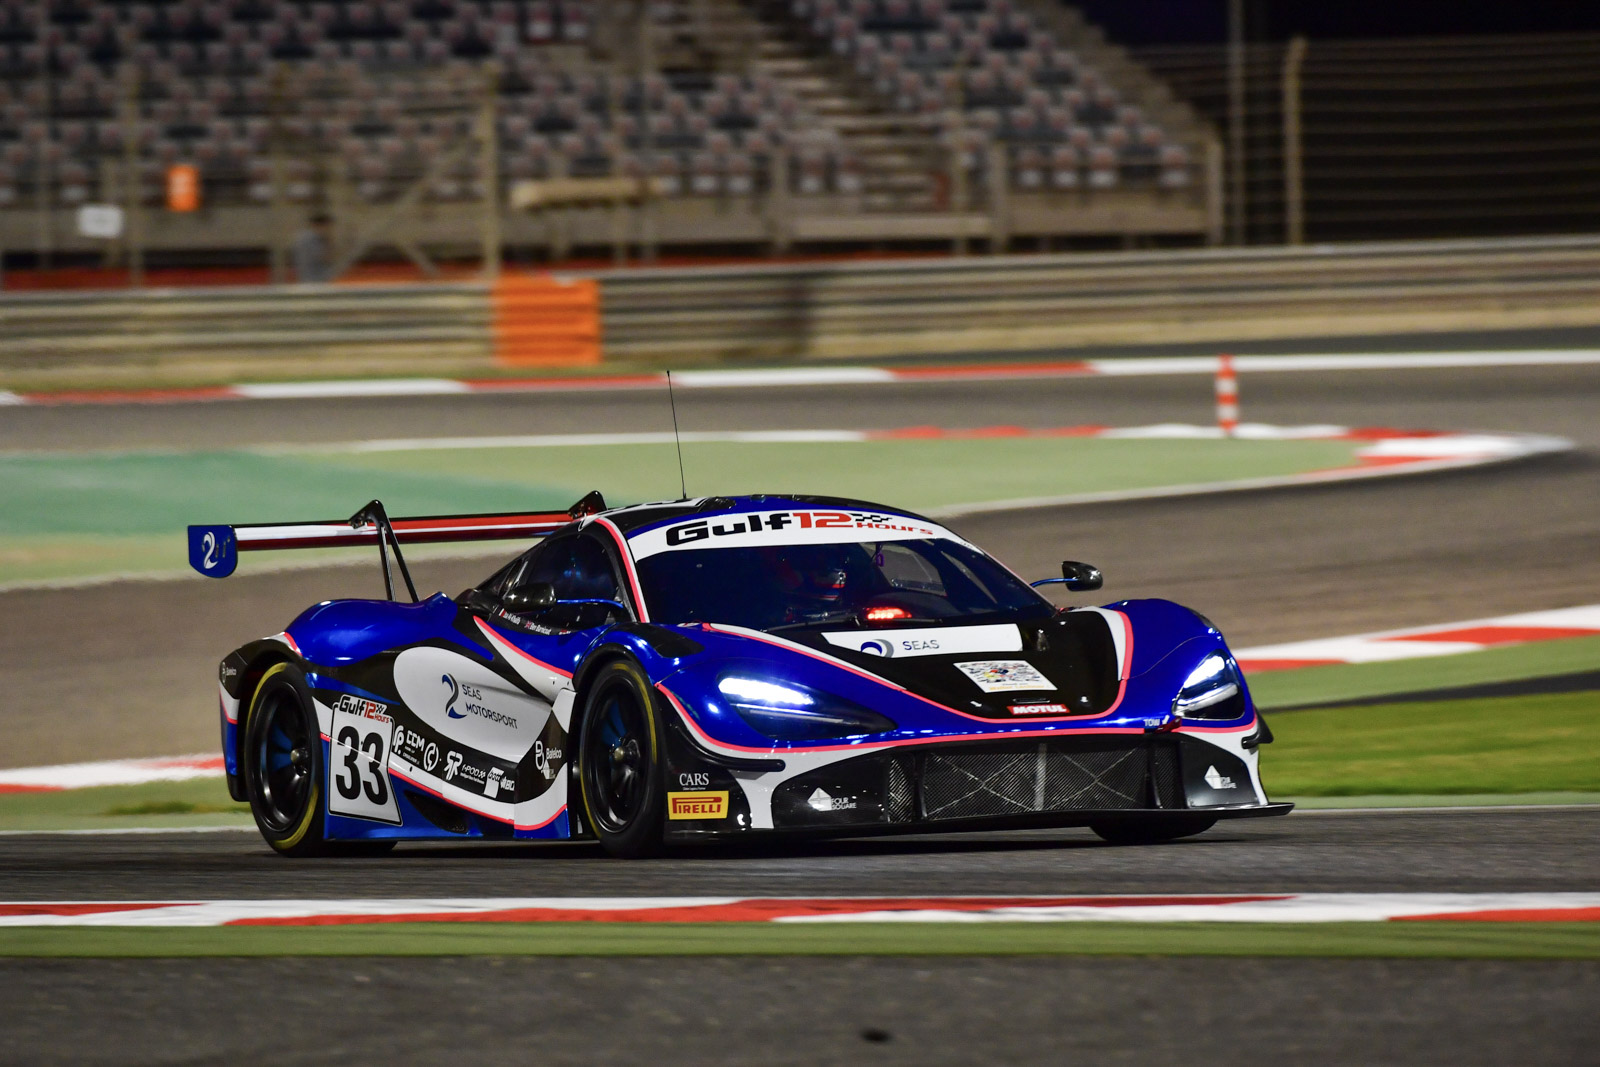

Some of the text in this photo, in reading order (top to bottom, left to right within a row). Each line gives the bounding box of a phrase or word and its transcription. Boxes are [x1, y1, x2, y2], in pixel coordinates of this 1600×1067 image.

[666, 512, 792, 546] Gulf
[793, 512, 854, 529] 12
[902, 640, 940, 650] SEAS
[461, 684, 482, 701] SEAS
[339, 696, 365, 716] Gulf
[363, 701, 377, 720] 12
[465, 702, 518, 729] MOTORSPORT
[1012, 705, 1067, 714] MOTUL
[1143, 718, 1161, 727] TOW
[335, 725, 388, 806] 33
[679, 773, 710, 786] CARS
[672, 797, 722, 814] PIRELLI
